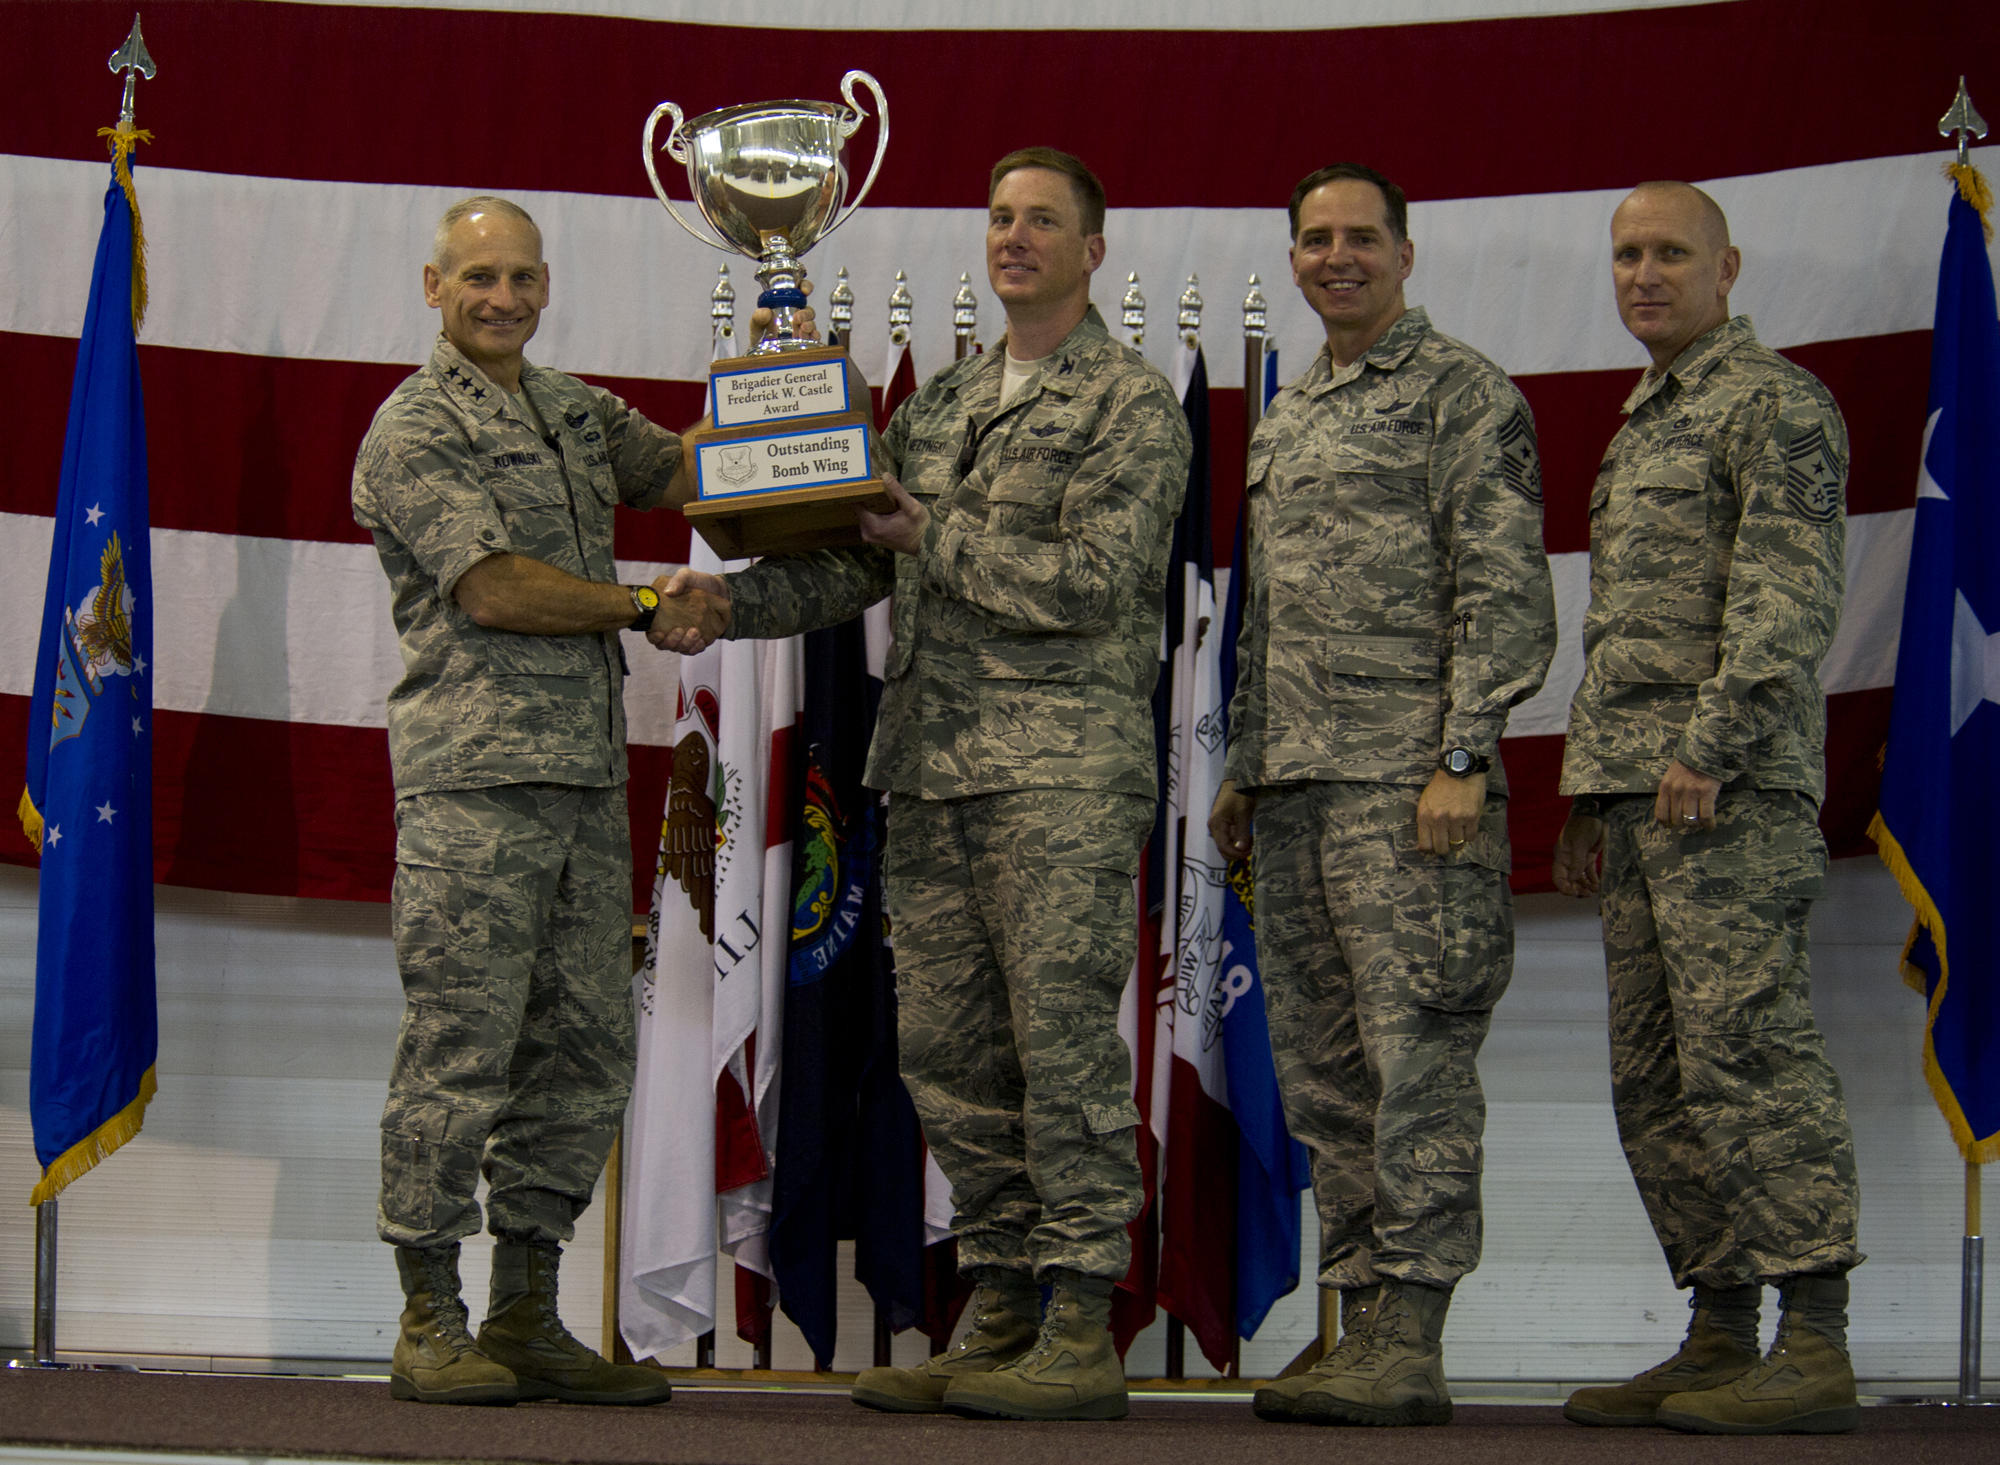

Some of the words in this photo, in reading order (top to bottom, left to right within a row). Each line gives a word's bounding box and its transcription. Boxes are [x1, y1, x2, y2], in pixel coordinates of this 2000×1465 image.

[731, 376, 781, 392] Brigadier
[785, 370, 827, 385] General
[727, 391, 779, 405] Frederick
[782, 387, 796, 398] W.
[799, 384, 833, 397] Castle
[763, 401, 799, 415] Award
[1350, 424, 1367, 436] U.S.
[1369, 420, 1386, 434] AIR
[1388, 419, 1425, 435] FORCE
[767, 437, 850, 457] Outstanding
[1019, 446, 1037, 460] AIR
[1036, 446, 1074, 465] FORCE
[494, 452, 543, 469] KOWALSKI
[772, 461, 809, 478] Bomb
[813, 458, 849, 474] Wing
